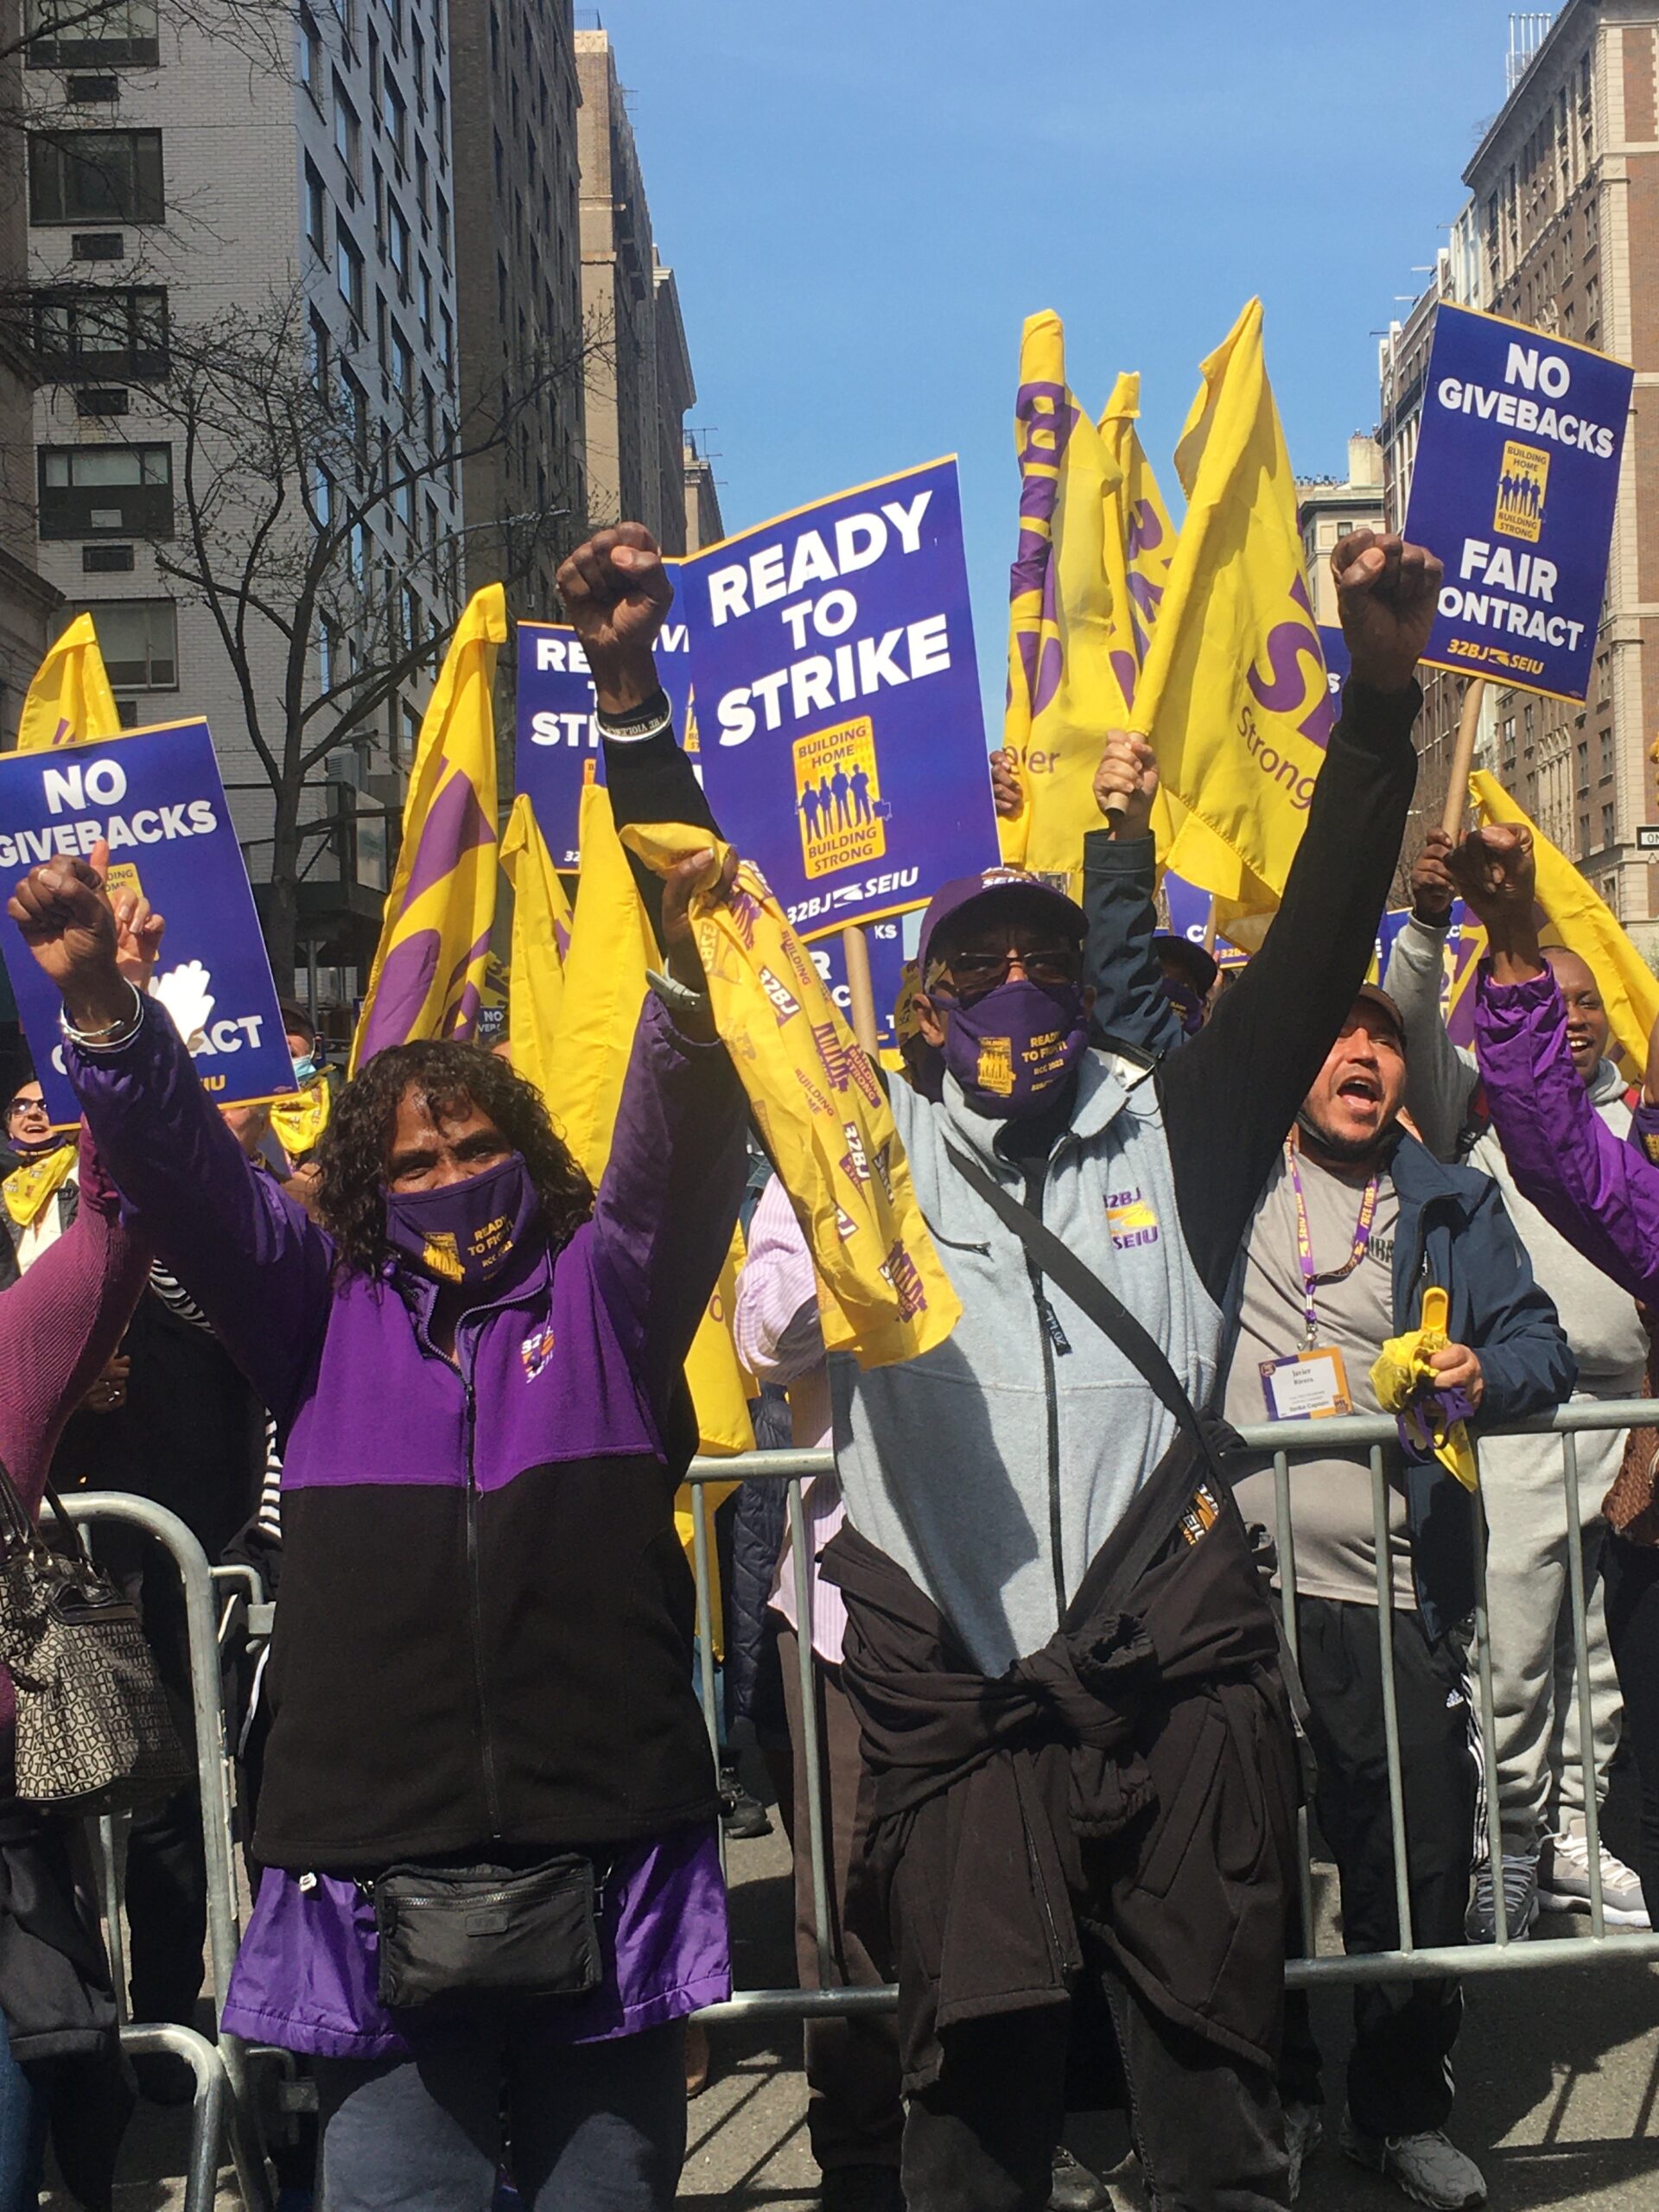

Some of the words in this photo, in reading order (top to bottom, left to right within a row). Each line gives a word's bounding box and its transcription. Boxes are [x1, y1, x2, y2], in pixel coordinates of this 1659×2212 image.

[1504, 342, 1570, 398] NO
[1438, 378, 1615, 459] GIVEBACKS
[1507, 446, 1547, 465] BUILDING
[1513, 458, 1538, 472] HOME
[1498, 512, 1537, 530] BUILDING
[1500, 522, 1533, 539] STRONG
[708, 489, 933, 627] READY
[1459, 537, 1558, 603] FAIR
[781, 589, 857, 651] TO
[1437, 587, 1584, 652] ONTRACT
[716, 613, 951, 747] STRIKE
[1447, 639, 1490, 661] 32BJ
[1510, 654, 1544, 675] SEIU
[798, 725, 867, 759] BUILDING
[811, 745, 855, 769] HOME
[42, 759, 127, 815] NO
[0, 800, 218, 868] GIVEBACKS
[564, 850, 581, 862] 32
[808, 826, 877, 859] BUILDING
[814, 843, 874, 873] STRONG
[787, 893, 831, 925] 32BJ
[864, 867, 918, 897] SEIU
[781, 930, 810, 985] BUILDING
[759, 968, 801, 1015] 32BJ
[1021, 1051, 1039, 1063] TO
[795, 1068, 835, 1116] BUILDING
[843, 1125, 871, 1178] 32BJ
[467, 1243, 486, 1256] TO
[1113, 1226, 1159, 1250] SEIU
